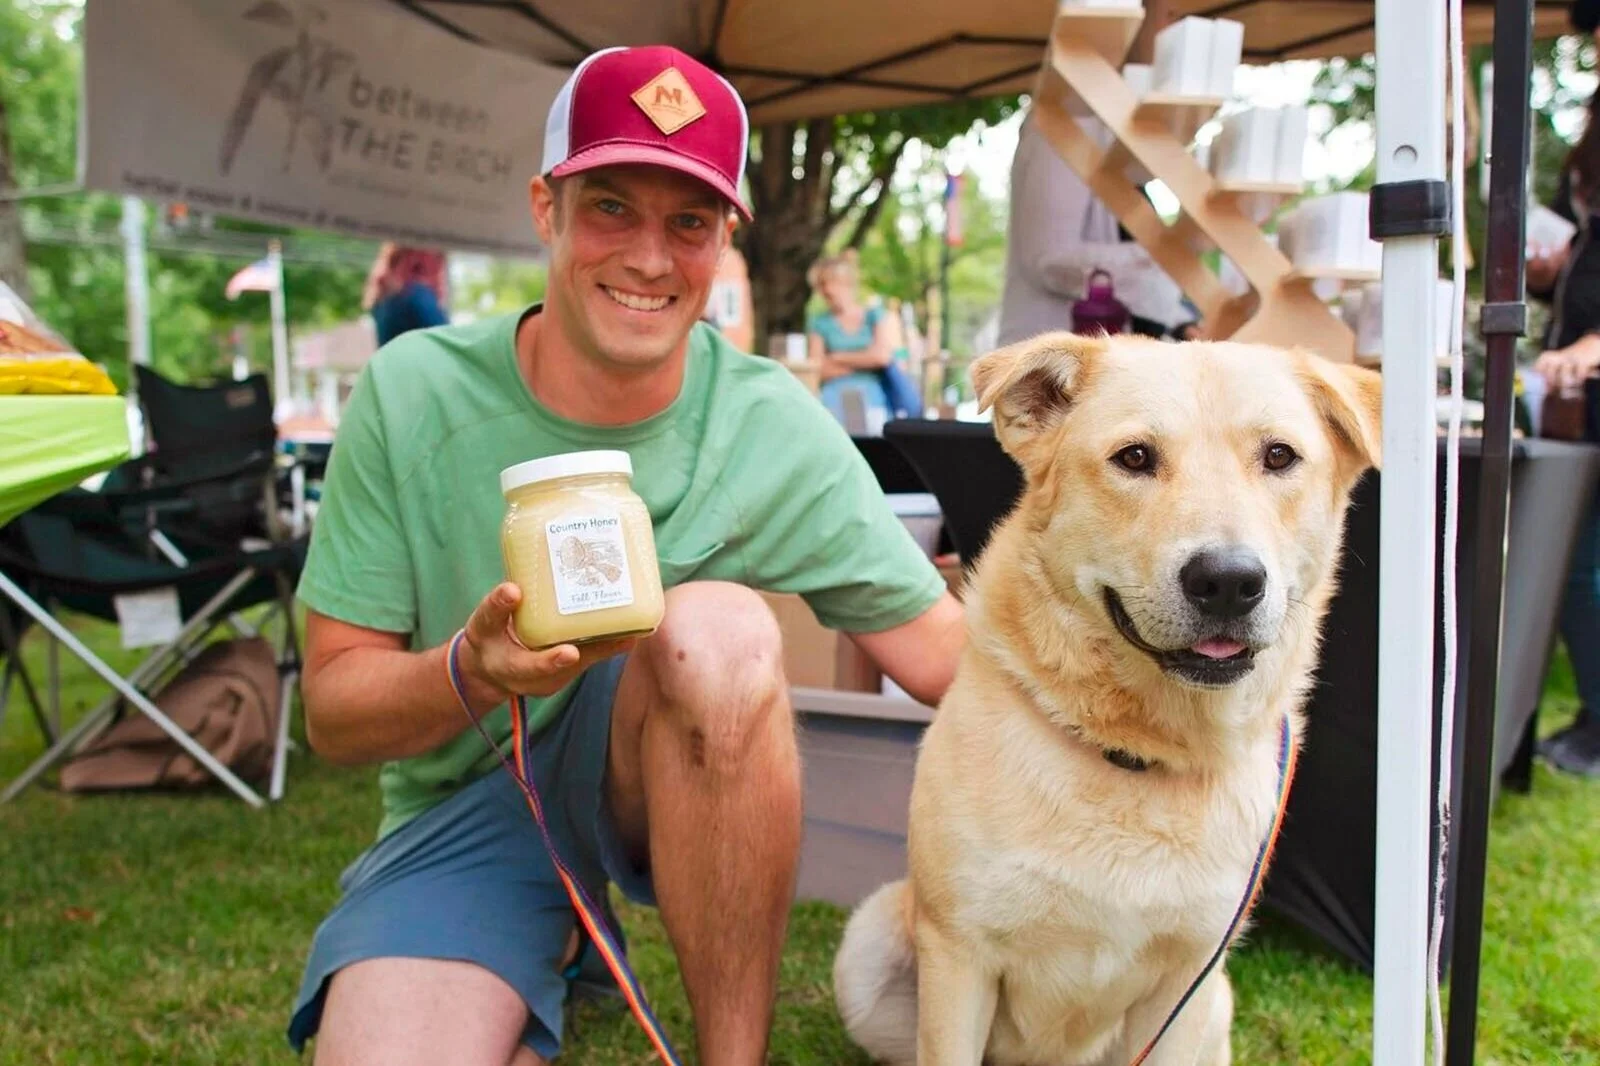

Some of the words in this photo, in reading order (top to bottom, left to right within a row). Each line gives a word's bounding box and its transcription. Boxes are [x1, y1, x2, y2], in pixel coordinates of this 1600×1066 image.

[348, 71, 490, 134] between
[339, 116, 419, 170] THE
[549, 521, 588, 534] Country
[589, 517, 618, 529] Honey
